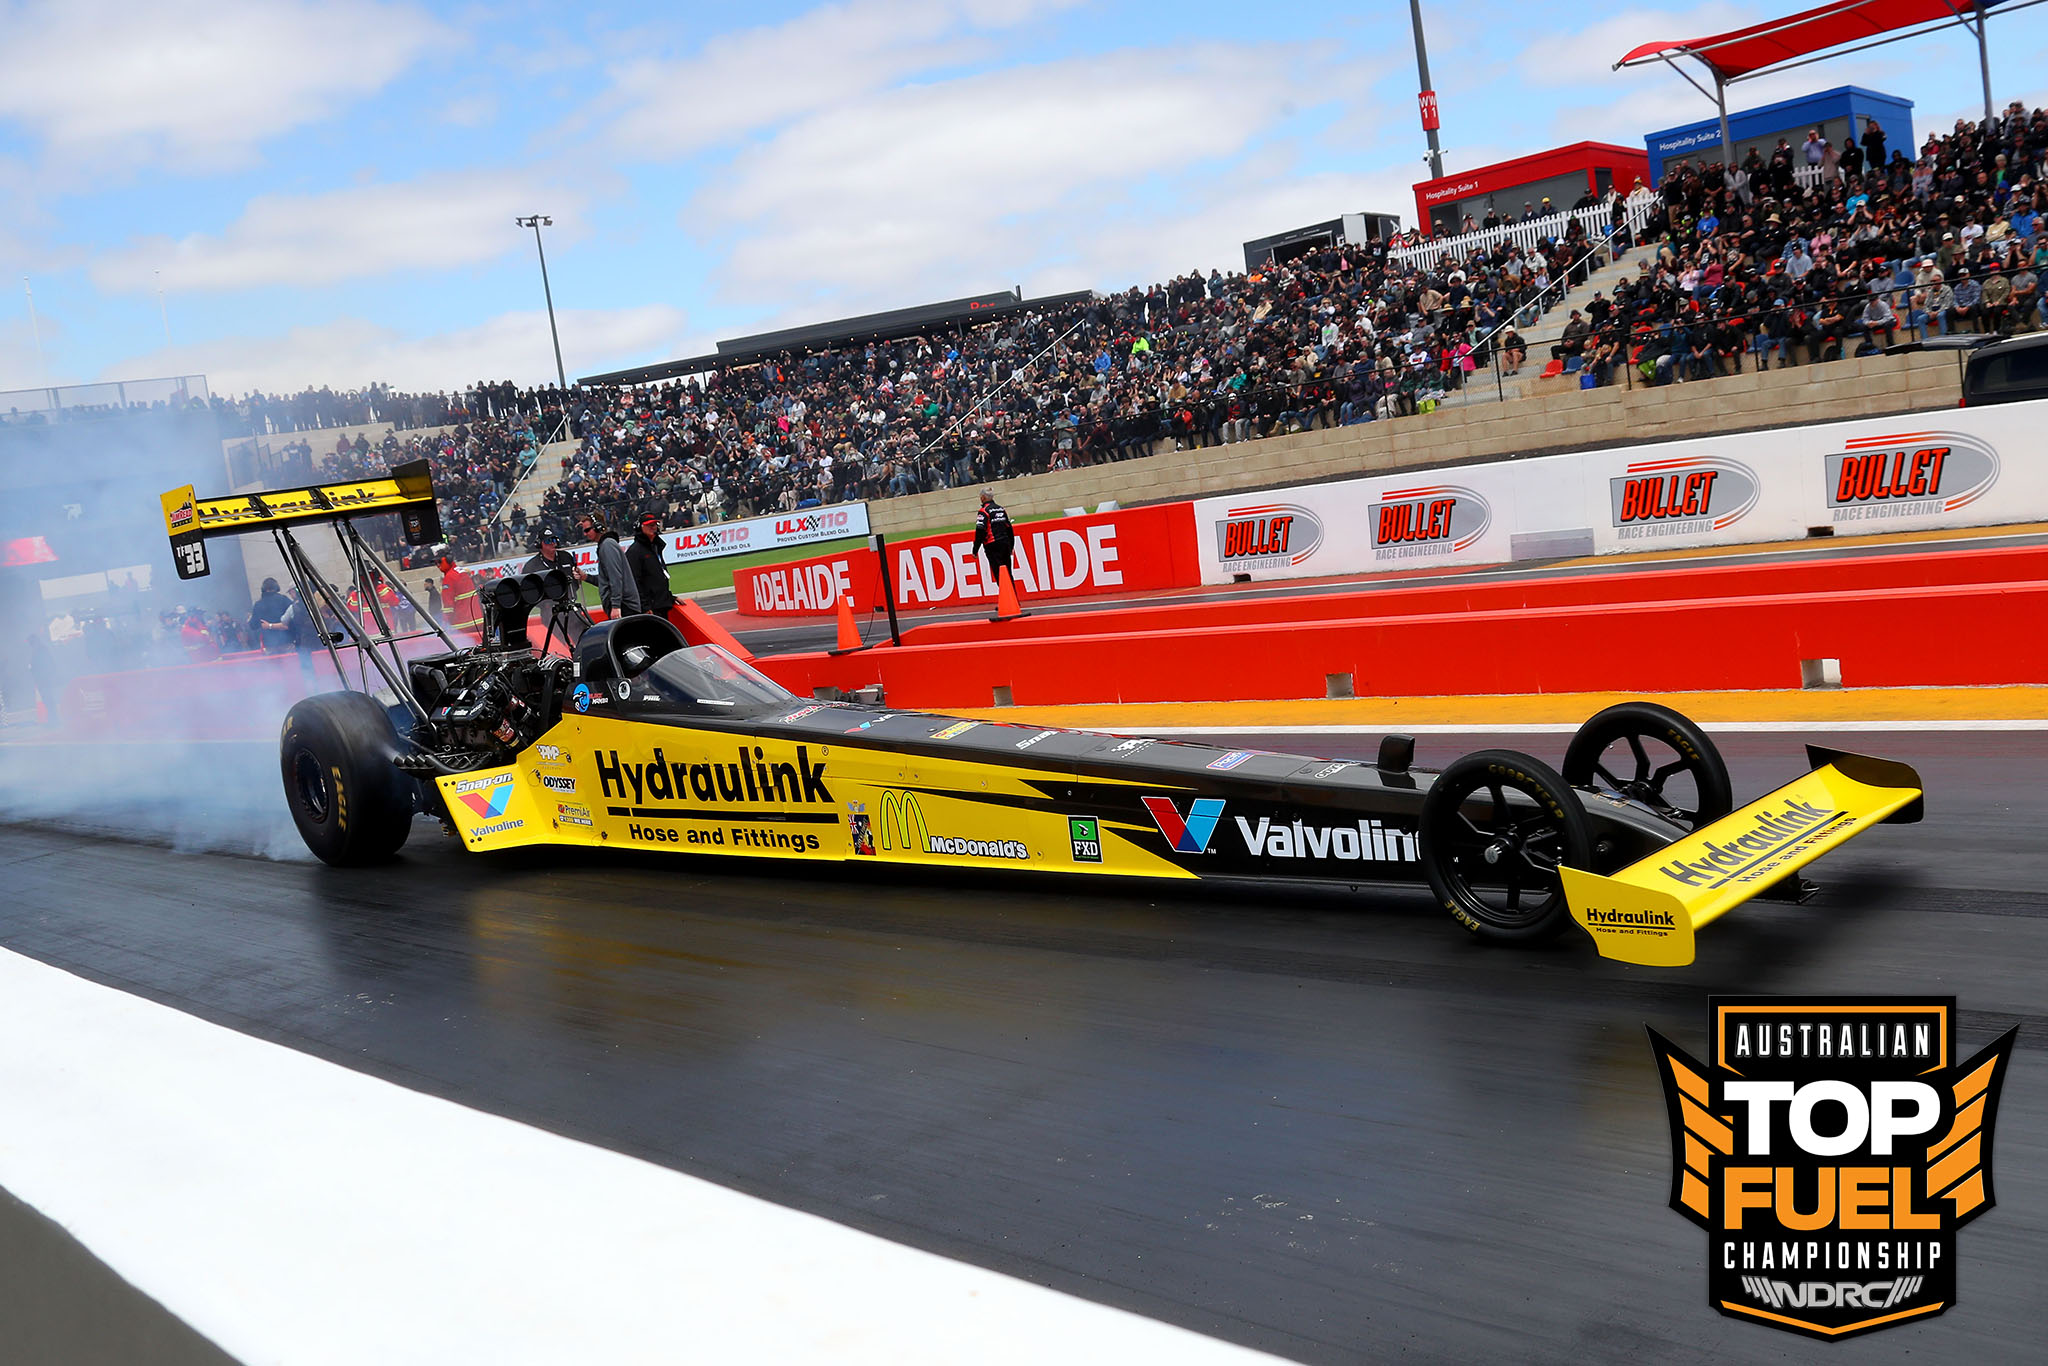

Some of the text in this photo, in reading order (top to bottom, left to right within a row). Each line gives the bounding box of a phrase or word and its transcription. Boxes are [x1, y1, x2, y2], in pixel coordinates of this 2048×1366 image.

[1659, 129, 1721, 151] Hospitality Suite 2
[1425, 187, 1457, 200] Hospitality
[1458, 184, 1473, 192] Suite
[1836, 447, 1951, 502] BULLET
[1619, 470, 1718, 523] BULLET
[1833, 502, 1943, 521] RACE ENGINEERING
[776, 511, 848, 535] ULX 110
[1377, 498, 1456, 545] BULLET
[1618, 520, 1713, 539] RACE ENGINEERING
[676, 526, 749, 550] ULX 110
[777, 535, 797, 543] PROVEN
[1223, 516, 1293, 559] BULLET
[1376, 543, 1453, 560] RACE ENGINEERING
[176, 541, 205, 574] TF 33
[899, 524, 1124, 604] ADELAIDE
[1223, 557, 1291, 572] RACE ENGINEERING
[752, 560, 855, 611] ADELAIDE
[1667, 728, 1700, 760] EAGLE
[456, 773, 513, 794] Snap-on
[543, 776, 576, 790] ODYSSEY
[594, 745, 836, 805] Hydraulink
[331, 766, 347, 832] EAGLE
[1488, 764, 1565, 818] GOODYEAR
[470, 819, 524, 837] Valvoline
[629, 823, 820, 853] Hose and Fittings
[1235, 816, 1421, 862] Valvolin
[1658, 798, 1835, 887] Hydraulink
[930, 836, 1028, 859] McDonald's
[1737, 817, 1858, 883] Hose and Fittings
[1444, 900, 1481, 932] EAGLE
[1586, 907, 1676, 926] Hydraulink
